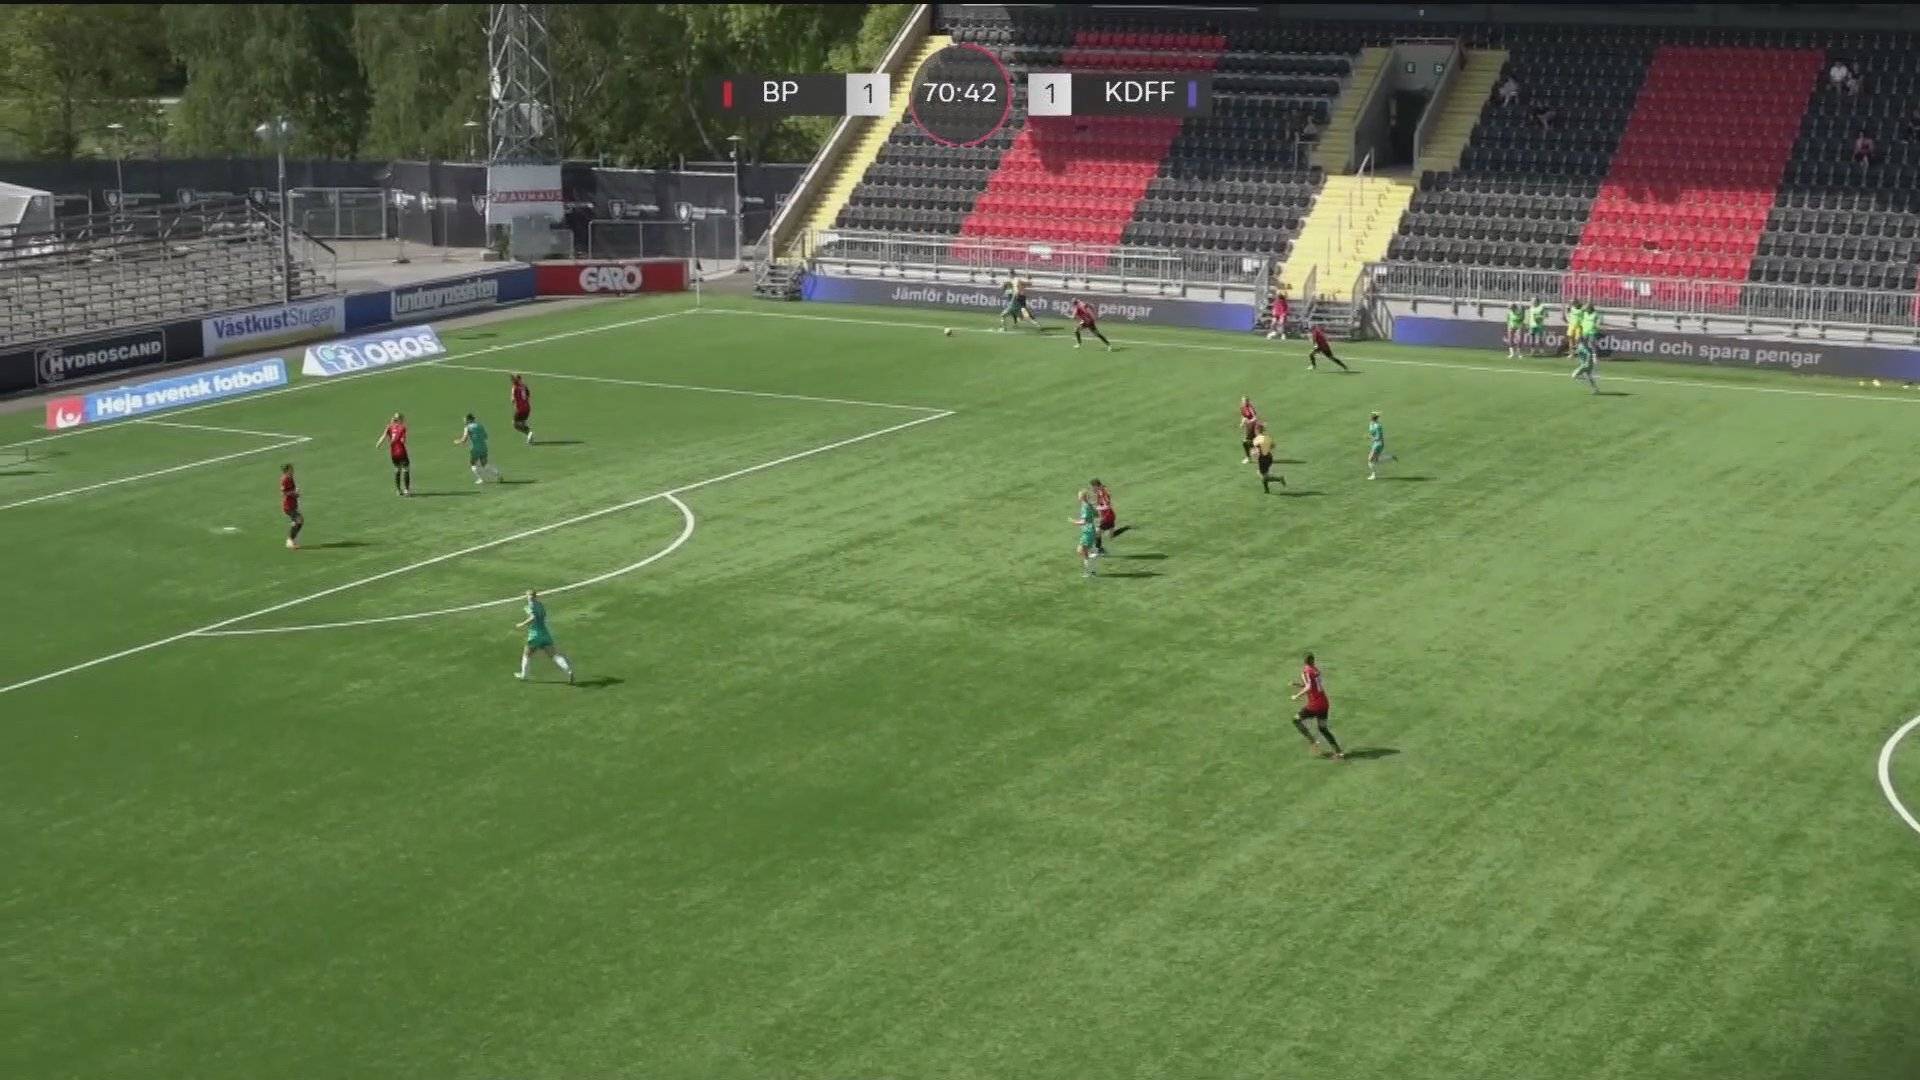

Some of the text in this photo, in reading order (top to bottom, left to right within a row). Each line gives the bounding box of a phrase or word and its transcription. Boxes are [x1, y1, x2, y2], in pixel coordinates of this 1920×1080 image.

[579, 265, 643, 292] GARO
[891, 286, 943, 302] Jämför
[1098, 302, 1153, 320] pengar
[50, 341, 162, 373] HYDROSCAND
[364, 334, 439, 364] OBOS
[1659, 340, 1693, 356] och
[1699, 344, 1749, 362] spara
[1755, 349, 1823, 368] pengar
[96, 393, 143, 416] Heja
[145, 378, 212, 406] svensk
